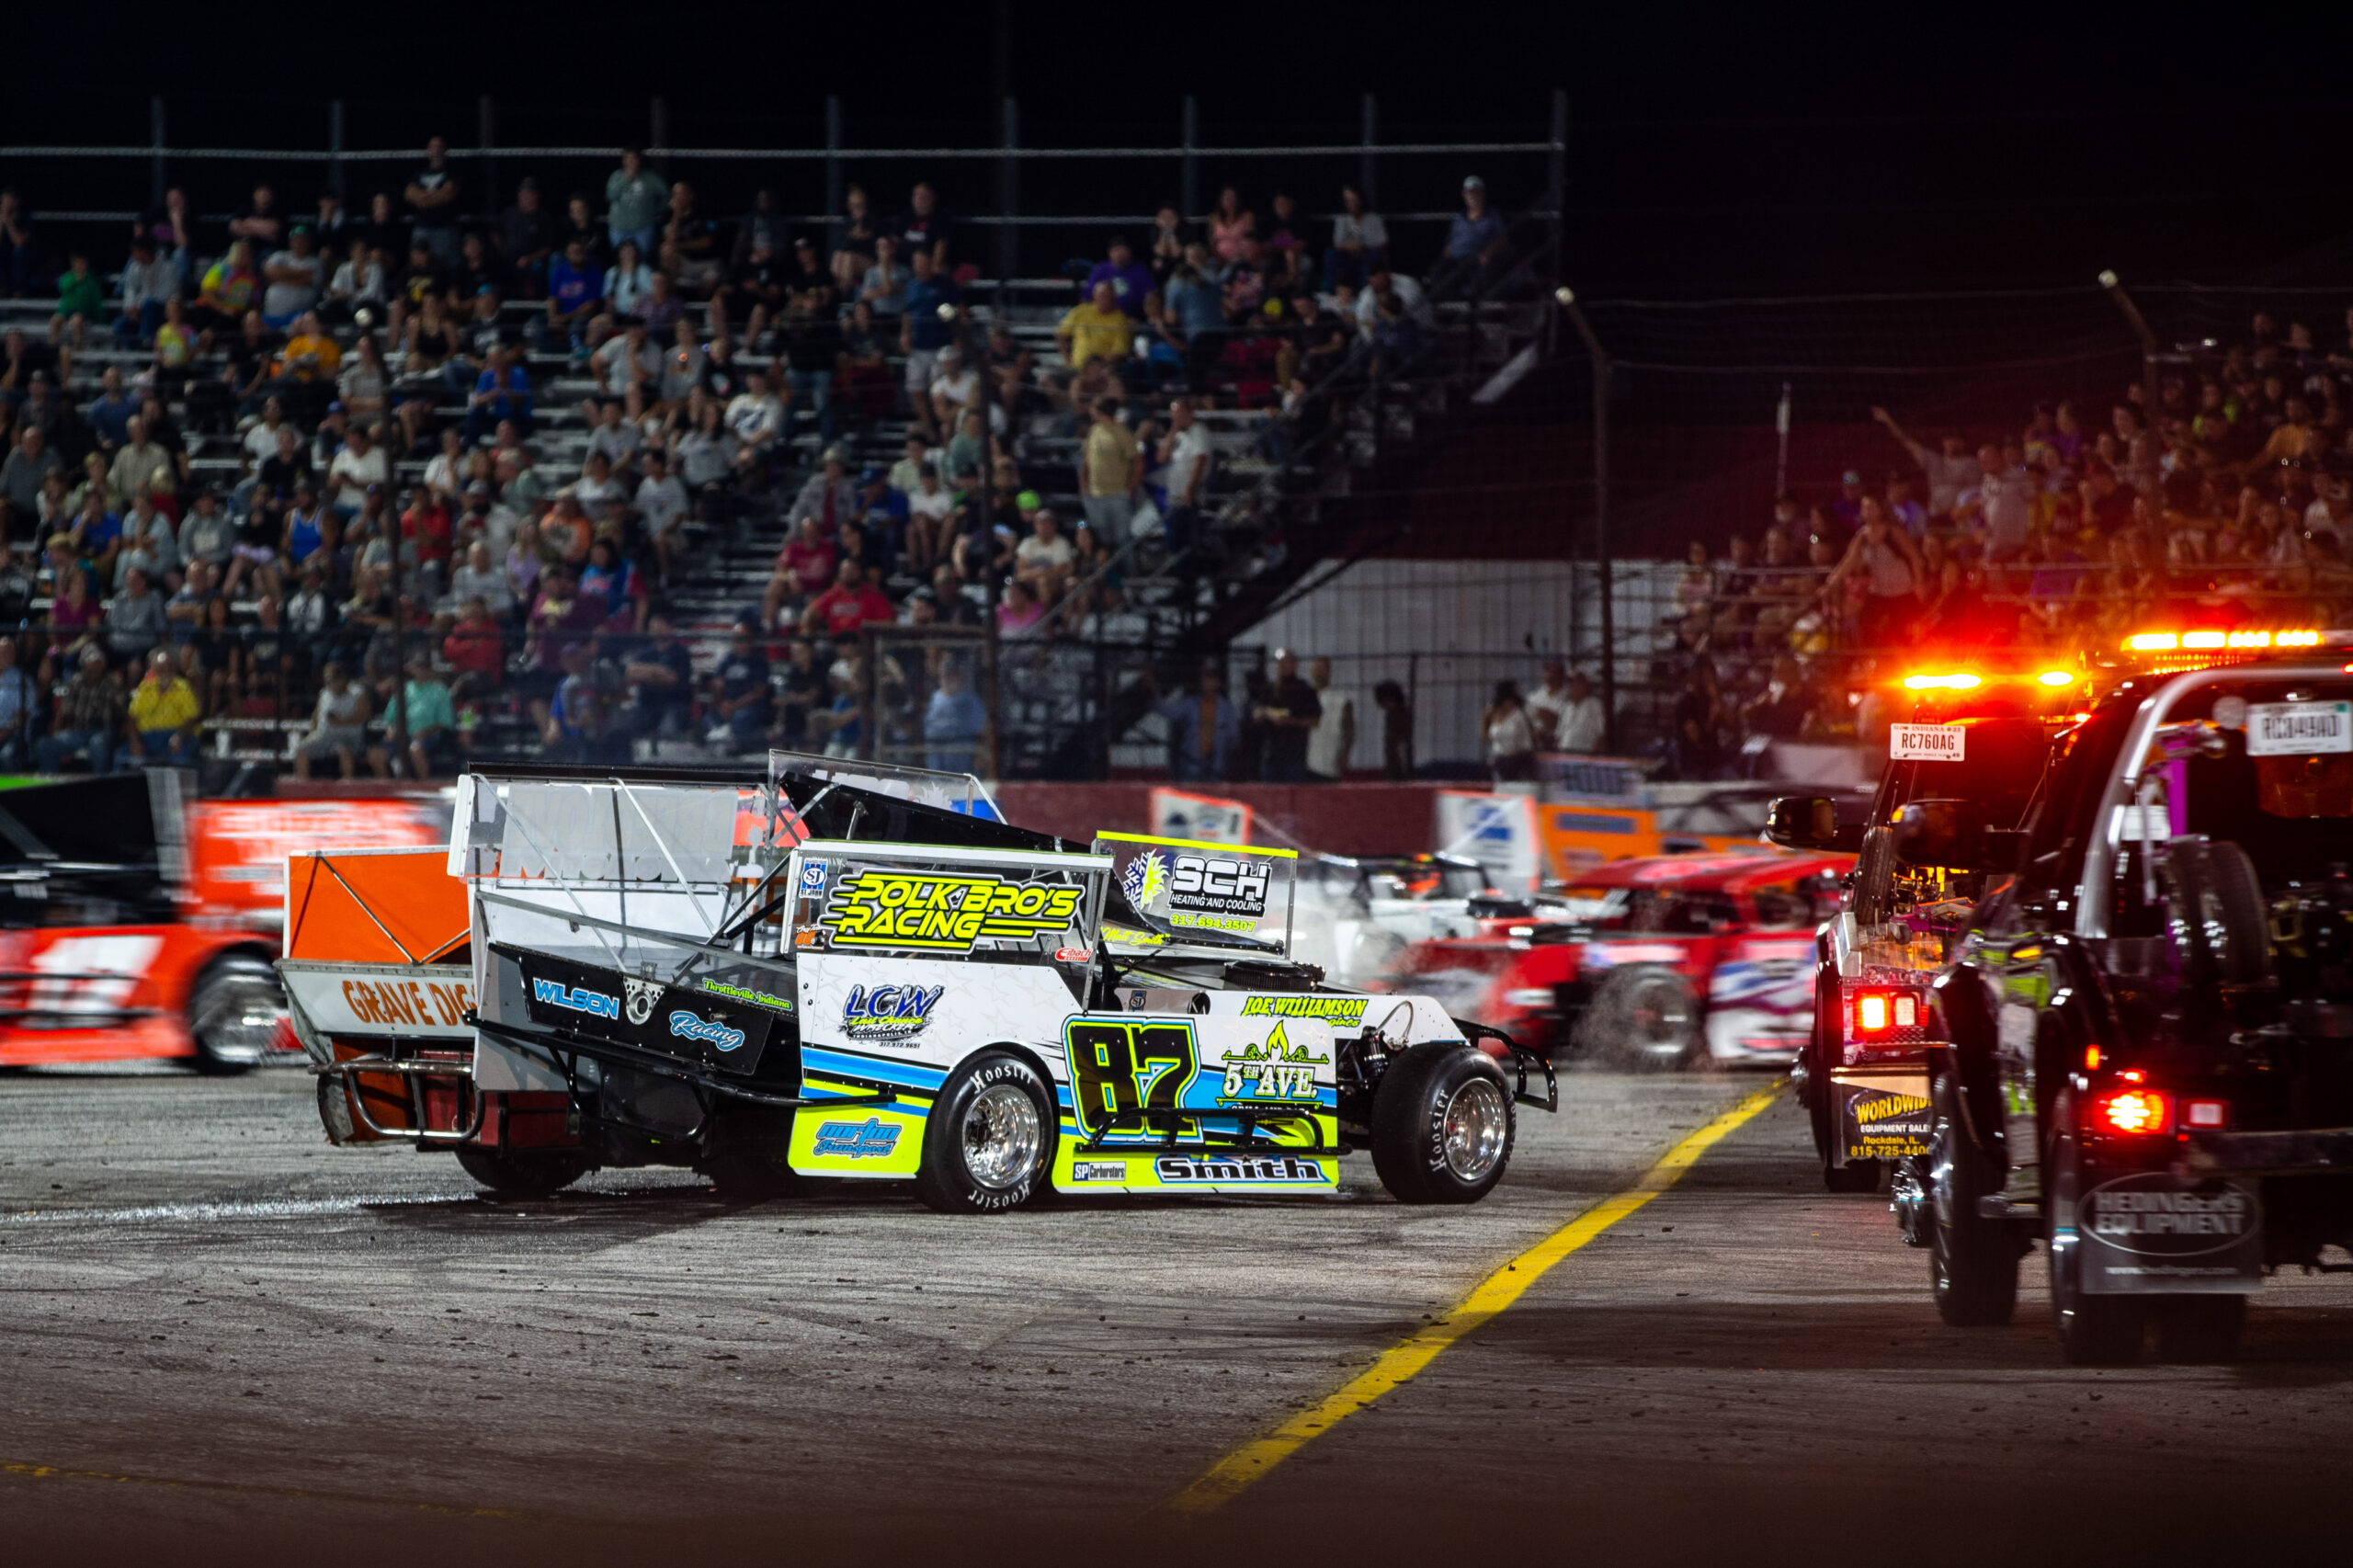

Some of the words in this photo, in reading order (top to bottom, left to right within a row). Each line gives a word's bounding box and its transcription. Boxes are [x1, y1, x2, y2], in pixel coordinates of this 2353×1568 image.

[1901, 733, 1955, 750] RC760AG
[805, 869, 823, 884] SJ
[1171, 855, 1269, 899] SCH
[846, 879, 959, 910] POLK
[964, 884, 1083, 917] BRO'S
[1170, 892, 1207, 906] HEATING
[1206, 897, 1226, 908] AND
[1225, 900, 1264, 912] COOLING
[835, 904, 986, 939] RACING
[1170, 914, 1256, 933] 317.694.3507
[1055, 947, 1094, 961] Eibach
[342, 980, 437, 1027] GRAVE
[426, 982, 478, 1027] DIG
[533, 978, 620, 1020] WILSON
[756, 993, 791, 1009] Indiana
[845, 984, 945, 1018] LCW
[1241, 995, 1275, 1017] JOE
[673, 1014, 744, 1049] Racing
[1069, 1022, 1199, 1136] 87
[1255, 1065, 1318, 1098] AVE.
[1428, 1089, 1449, 1173] Hoosier
[1860, 1124, 1906, 1133] EQUIPMENT
[1074, 1163, 1088, 1180] SP
[1157, 1155, 1322, 1181] Smith
